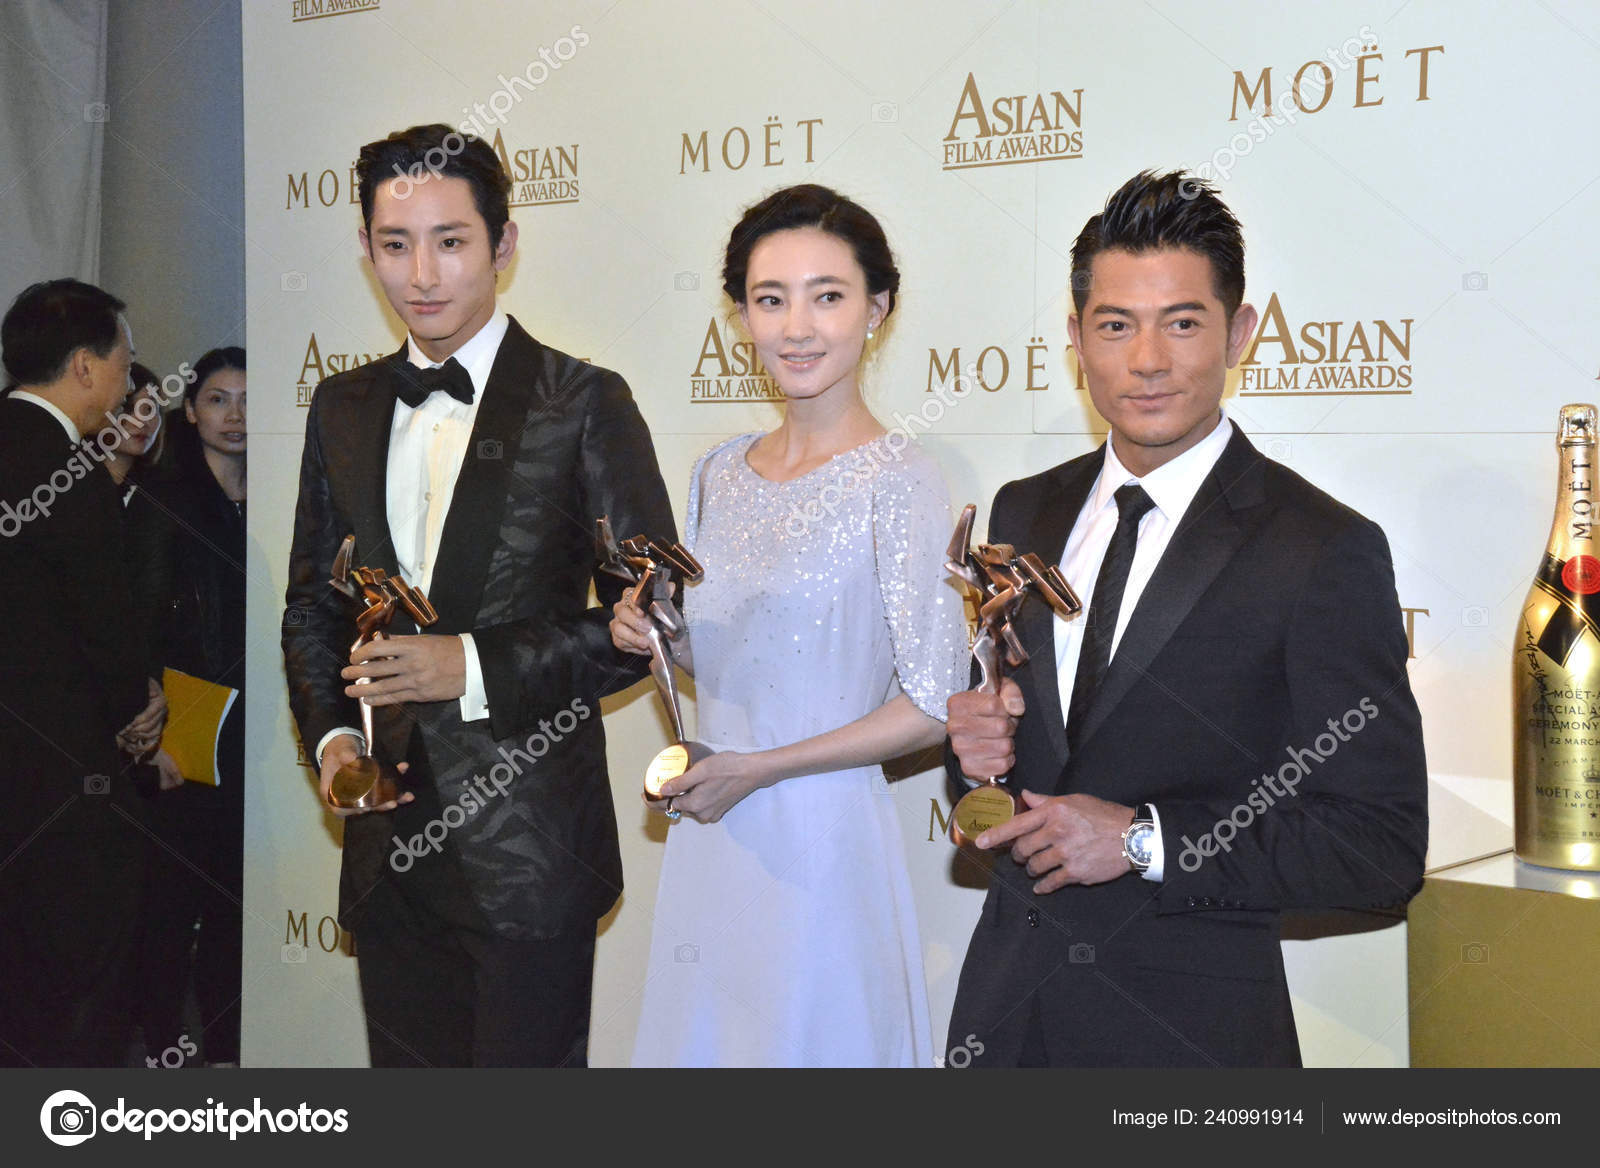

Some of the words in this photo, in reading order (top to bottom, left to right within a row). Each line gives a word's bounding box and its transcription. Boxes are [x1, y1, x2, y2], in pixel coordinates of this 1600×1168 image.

[943, 137, 992, 165] FILM
[995, 131, 1084, 160] AWARDS
[518, 180, 579, 202] AWARDS
[691, 379, 732, 398] FILM
[1240, 368, 1301, 390] FILM
[1305, 365, 1413, 390] AWARDS
